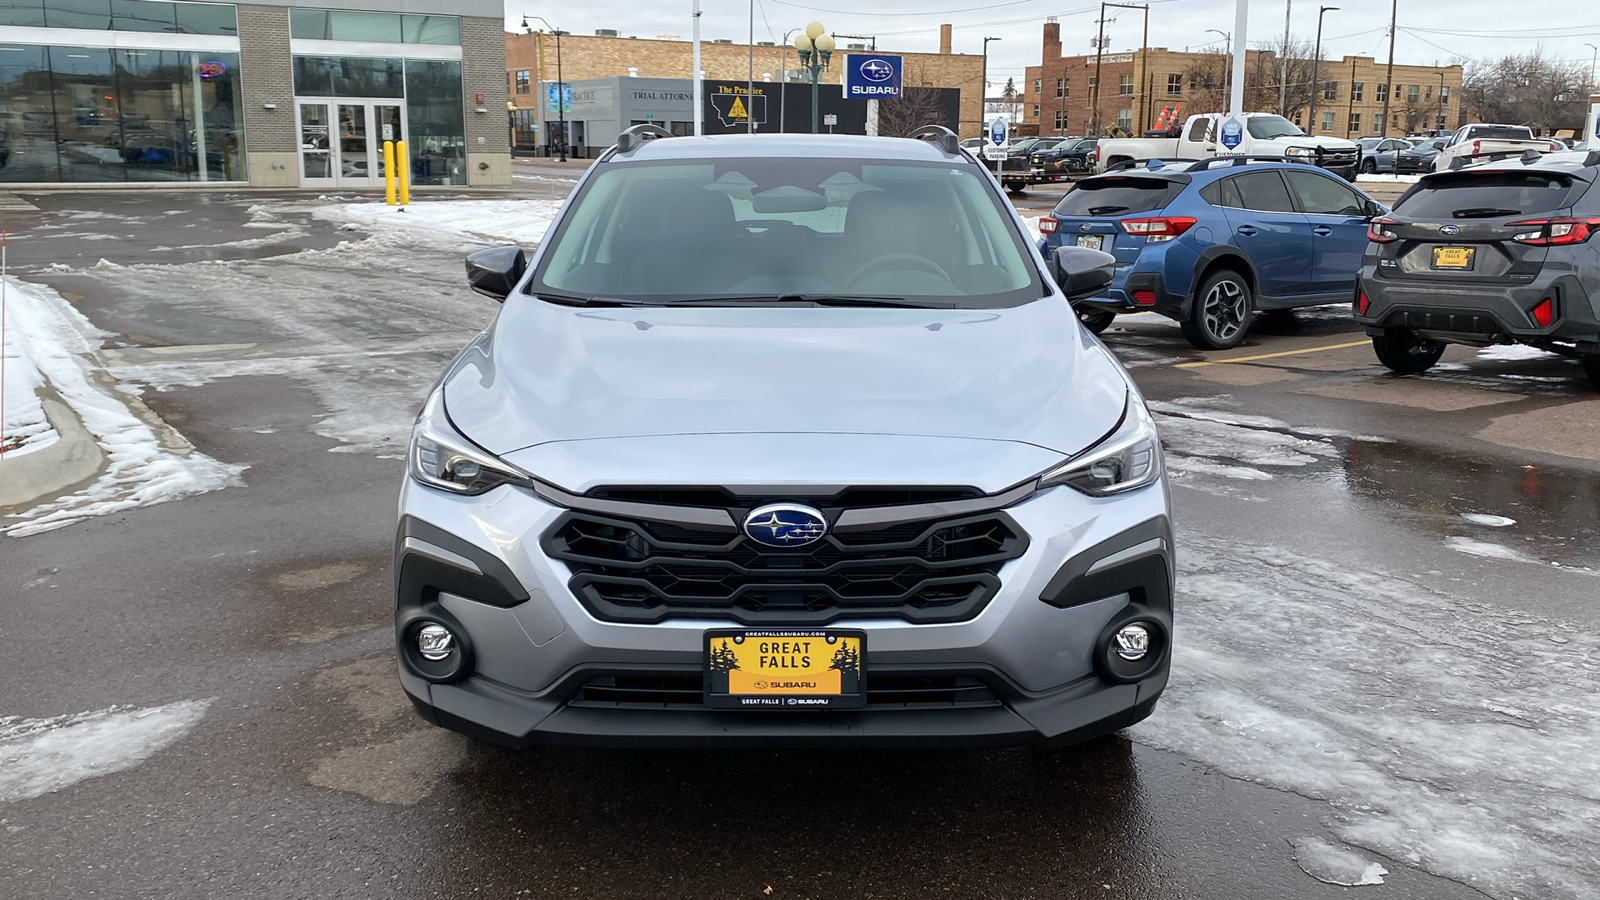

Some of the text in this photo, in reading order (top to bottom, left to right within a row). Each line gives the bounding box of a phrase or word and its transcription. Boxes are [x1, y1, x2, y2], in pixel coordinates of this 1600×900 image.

[197, 63, 224, 74] OPEN
[734, 86, 763, 94] Pracice
[852, 86, 899, 94] SUBARU
[633, 91, 704, 100] TRIAL ATTORNES
[759, 642, 811, 654] GREAT
[759, 656, 811, 668] FALLS
